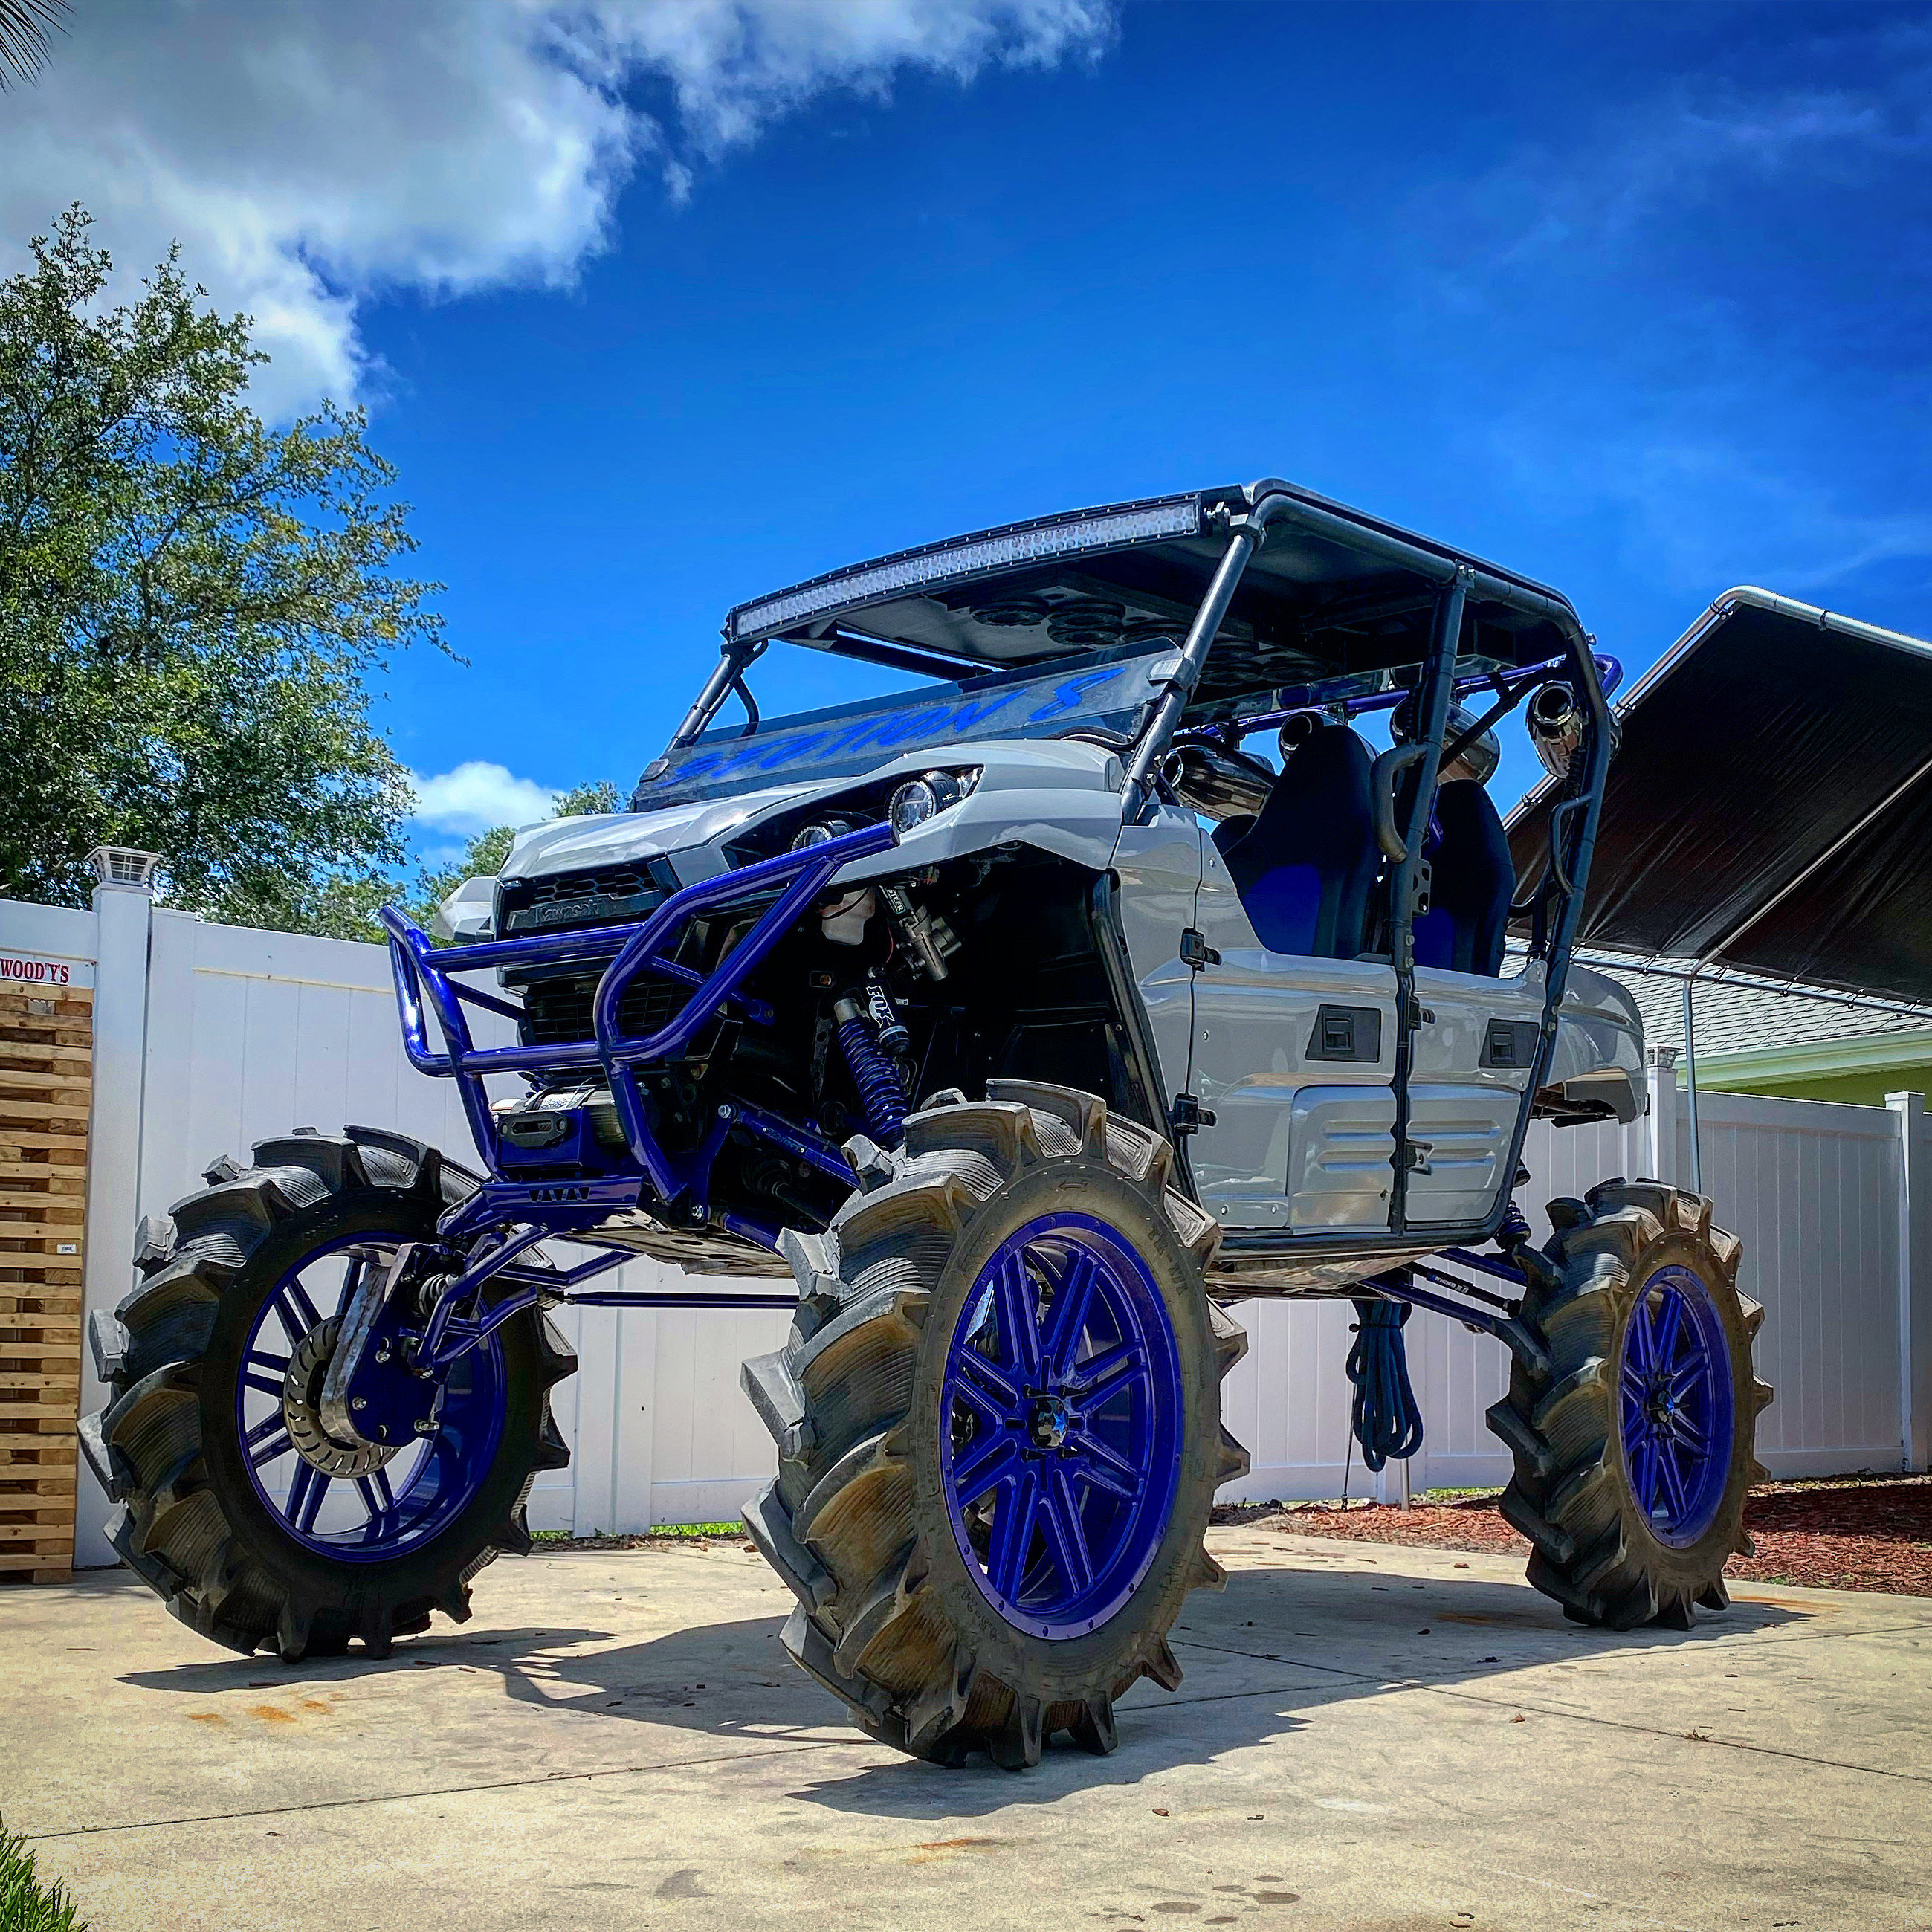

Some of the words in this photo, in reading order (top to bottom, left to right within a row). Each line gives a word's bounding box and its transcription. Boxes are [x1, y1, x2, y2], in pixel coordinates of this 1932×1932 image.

[0, 958, 69, 983] WOOD'YS
[866, 985, 895, 1028] FOX
[1434, 1276, 1457, 1288] RHINO
